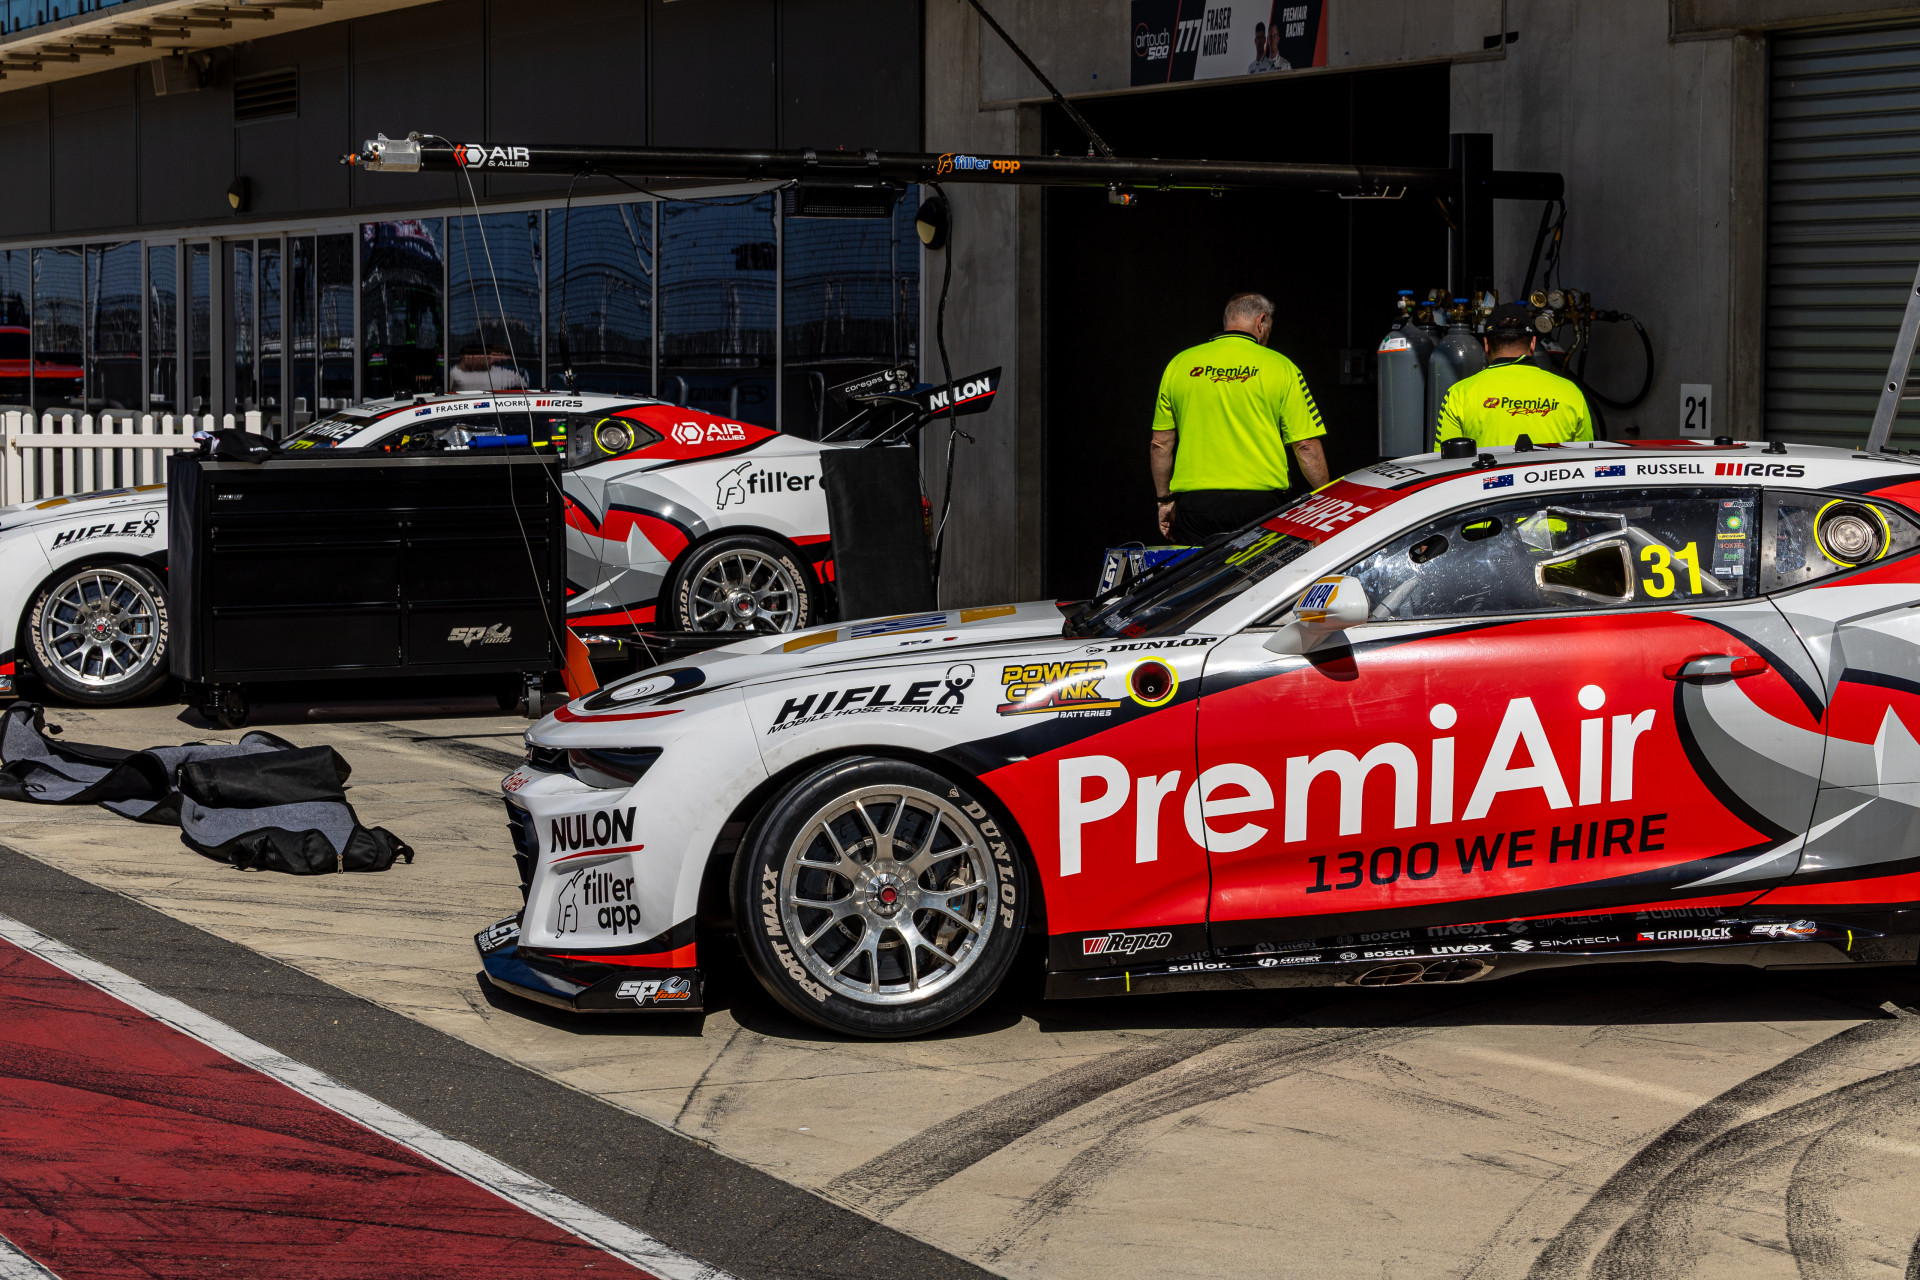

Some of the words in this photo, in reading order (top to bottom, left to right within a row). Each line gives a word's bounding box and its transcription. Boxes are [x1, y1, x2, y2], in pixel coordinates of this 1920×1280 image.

[1206, 7, 1231, 31] FRASER
[1283, 6, 1307, 22] PREMIAIR
[1136, 28, 1170, 48] airtouch
[1175, 19, 1202, 53] 777
[1286, 22, 1305, 38] RACING
[1147, 45, 1169, 60] 500
[1203, 32, 1228, 57] MORRIS
[489, 146, 529, 160] AIR
[992, 160, 1020, 173] app
[1205, 365, 1259, 376] PremiAir
[845, 376, 883, 393] coregas
[930, 377, 990, 410] NULON
[436, 403, 469, 413] FRASER
[1501, 397, 1560, 411] PremiAir
[1684, 396, 1707, 430] 21
[313, 421, 364, 440] HIRE
[707, 424, 745, 435] AIR
[1524, 468, 1585, 484] OJEDA
[1637, 463, 1705, 475] RUSSELL
[1744, 463, 1806, 478] RRS
[1285, 496, 1373, 532] HIRE
[53, 514, 160, 546] HIFLEX
[50, 538, 84, 551] MOBILE
[1640, 541, 1703, 598] 31
[779, 556, 807, 591] SPORT
[796, 592, 809, 630] MAXX
[1300, 584, 1335, 609] NAPA
[32, 590, 49, 627] MAXX
[152, 595, 169, 667] DUNLOP
[447, 627, 487, 648] SP
[32, 628, 52, 667] SPORT
[1107, 637, 1217, 653] DUNLOP
[1002, 660, 1107, 685] POWER
[773, 668, 975, 725] HIFLEX
[767, 711, 835, 735] MOBILE
[835, 705, 885, 716] HOSE
[888, 704, 963, 715] SERVICE
[1060, 709, 1112, 718] BATTERIES
[1058, 684, 1657, 877] PremiAir
[550, 807, 637, 853] NULON
[962, 800, 1016, 929] DUNLOP
[1306, 840, 1440, 894] 1300
[1455, 828, 1537, 875] WE
[1549, 813, 1668, 864] HIRE
[762, 864, 783, 937] MAXX
[598, 903, 641, 935] app
[1751, 923, 1790, 937] SP
[1103, 932, 1172, 954] Repco
[1540, 935, 1620, 947] SIMTECH
[1657, 927, 1731, 940] GRIDLOCK
[1364, 949, 1415, 958] BOSCH
[1431, 943, 1494, 955] uvex
[772, 941, 832, 1002] SPORT
[1168, 962, 1231, 972] sailor.
[616, 981, 662, 1006] SP
